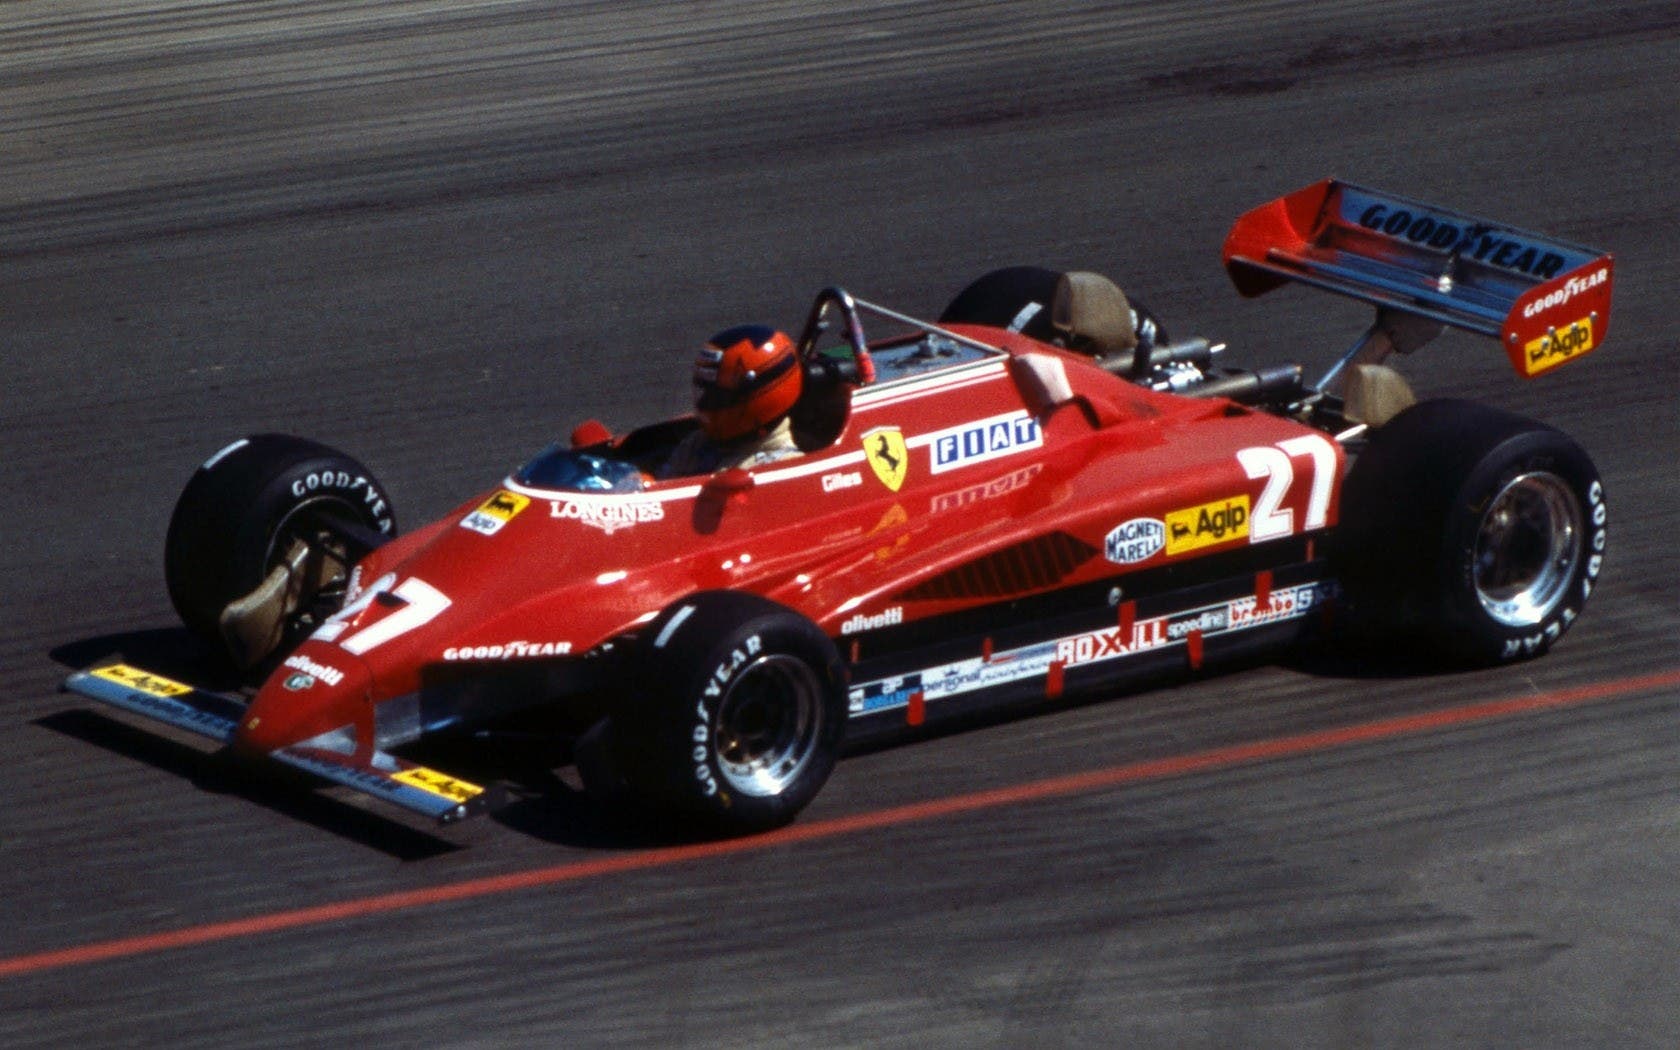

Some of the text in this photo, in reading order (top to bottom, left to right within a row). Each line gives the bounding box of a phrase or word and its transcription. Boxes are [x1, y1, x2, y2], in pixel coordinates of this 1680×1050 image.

[1523, 268, 1608, 318] GOODYEAR
[1548, 326, 1590, 357] Agip
[938, 416, 1039, 464] FIAT
[1237, 434, 1338, 544] 27
[550, 500, 665, 522] LONGINES
[1196, 502, 1247, 539] Agip
[309, 570, 453, 656] 27
[841, 606, 904, 637] olivetti
[443, 639, 573, 661] GOODYEAR
